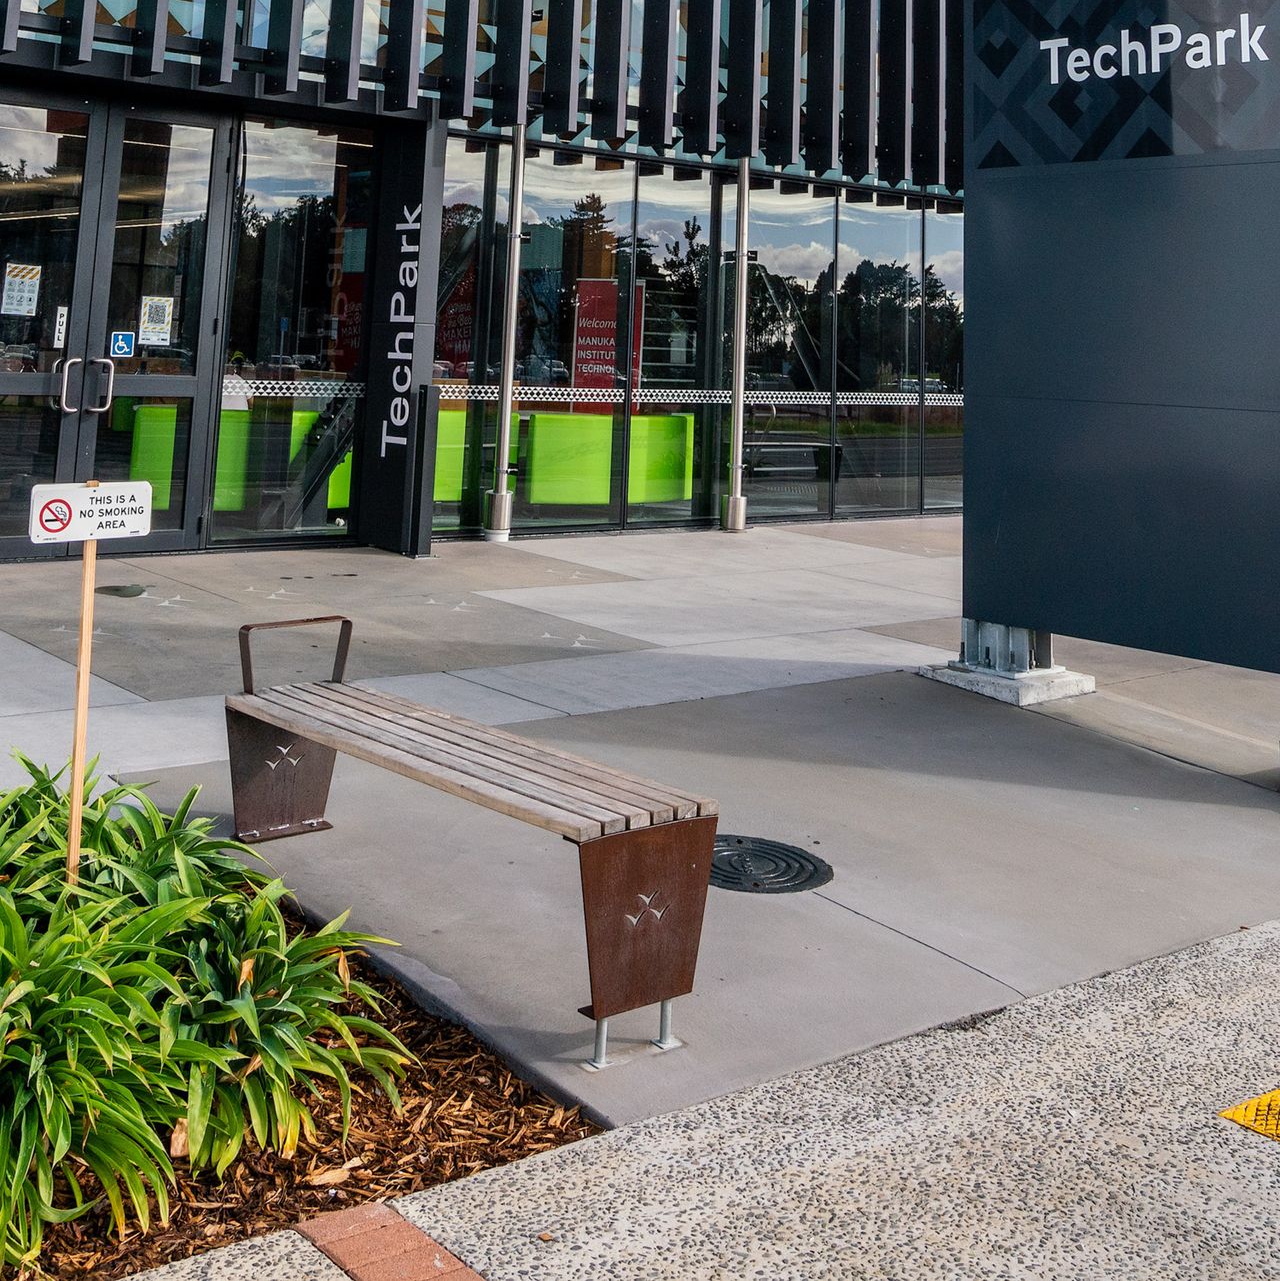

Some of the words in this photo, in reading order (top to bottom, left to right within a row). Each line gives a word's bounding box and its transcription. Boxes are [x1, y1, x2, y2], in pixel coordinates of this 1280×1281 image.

[1039, 13, 1270, 85] TechPark
[57, 313, 65, 342] PULL
[381, 203, 422, 458] TechPark
[577, 337, 616, 346] MANUKA
[577, 350, 616, 360] INSTITUT
[576, 363, 615, 374] TECHNOL
[89, 496, 112, 505] THIS
[116, 495, 126, 504] IS
[129, 494, 136, 503] A
[80, 509, 95, 518] NO
[98, 506, 144, 517] SMOKING
[97, 520, 126, 529] AREA
